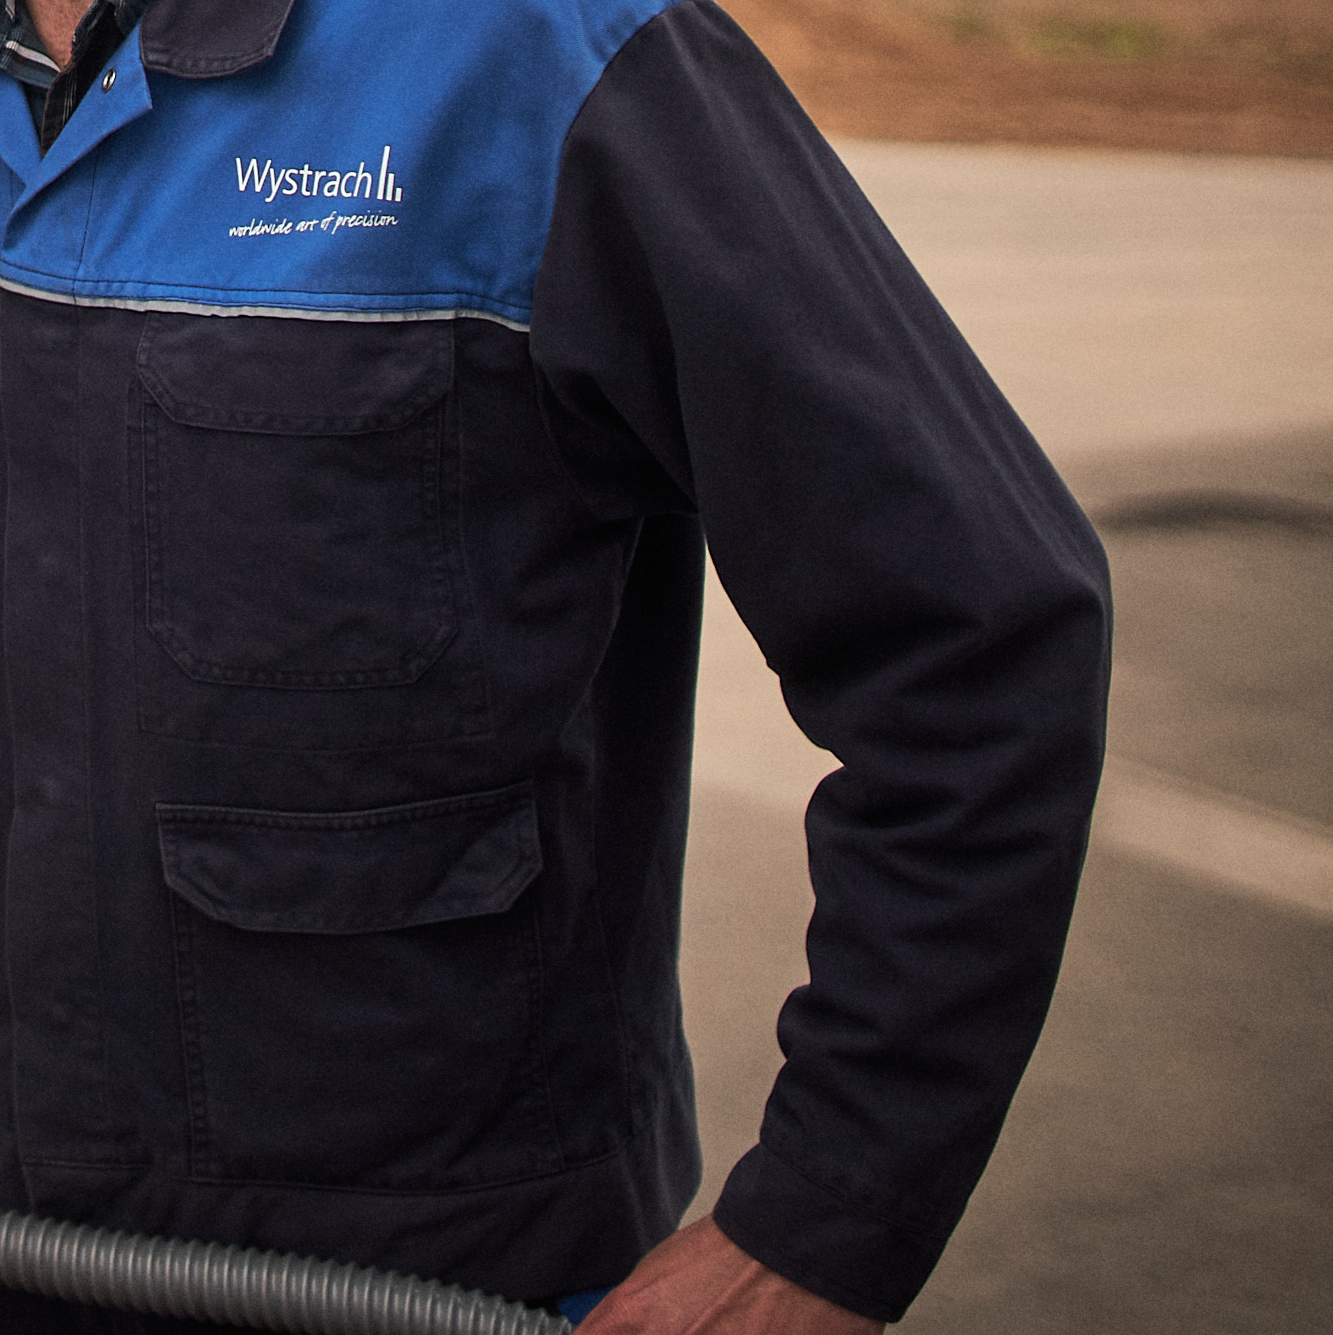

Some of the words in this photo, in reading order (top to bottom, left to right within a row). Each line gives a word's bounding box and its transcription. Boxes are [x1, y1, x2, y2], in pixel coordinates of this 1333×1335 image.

[235, 157, 373, 203] Wystrach
[228, 218, 294, 238] worldwide
[295, 219, 320, 232] art
[320, 210, 337, 231] of
[331, 209, 399, 235] precision
